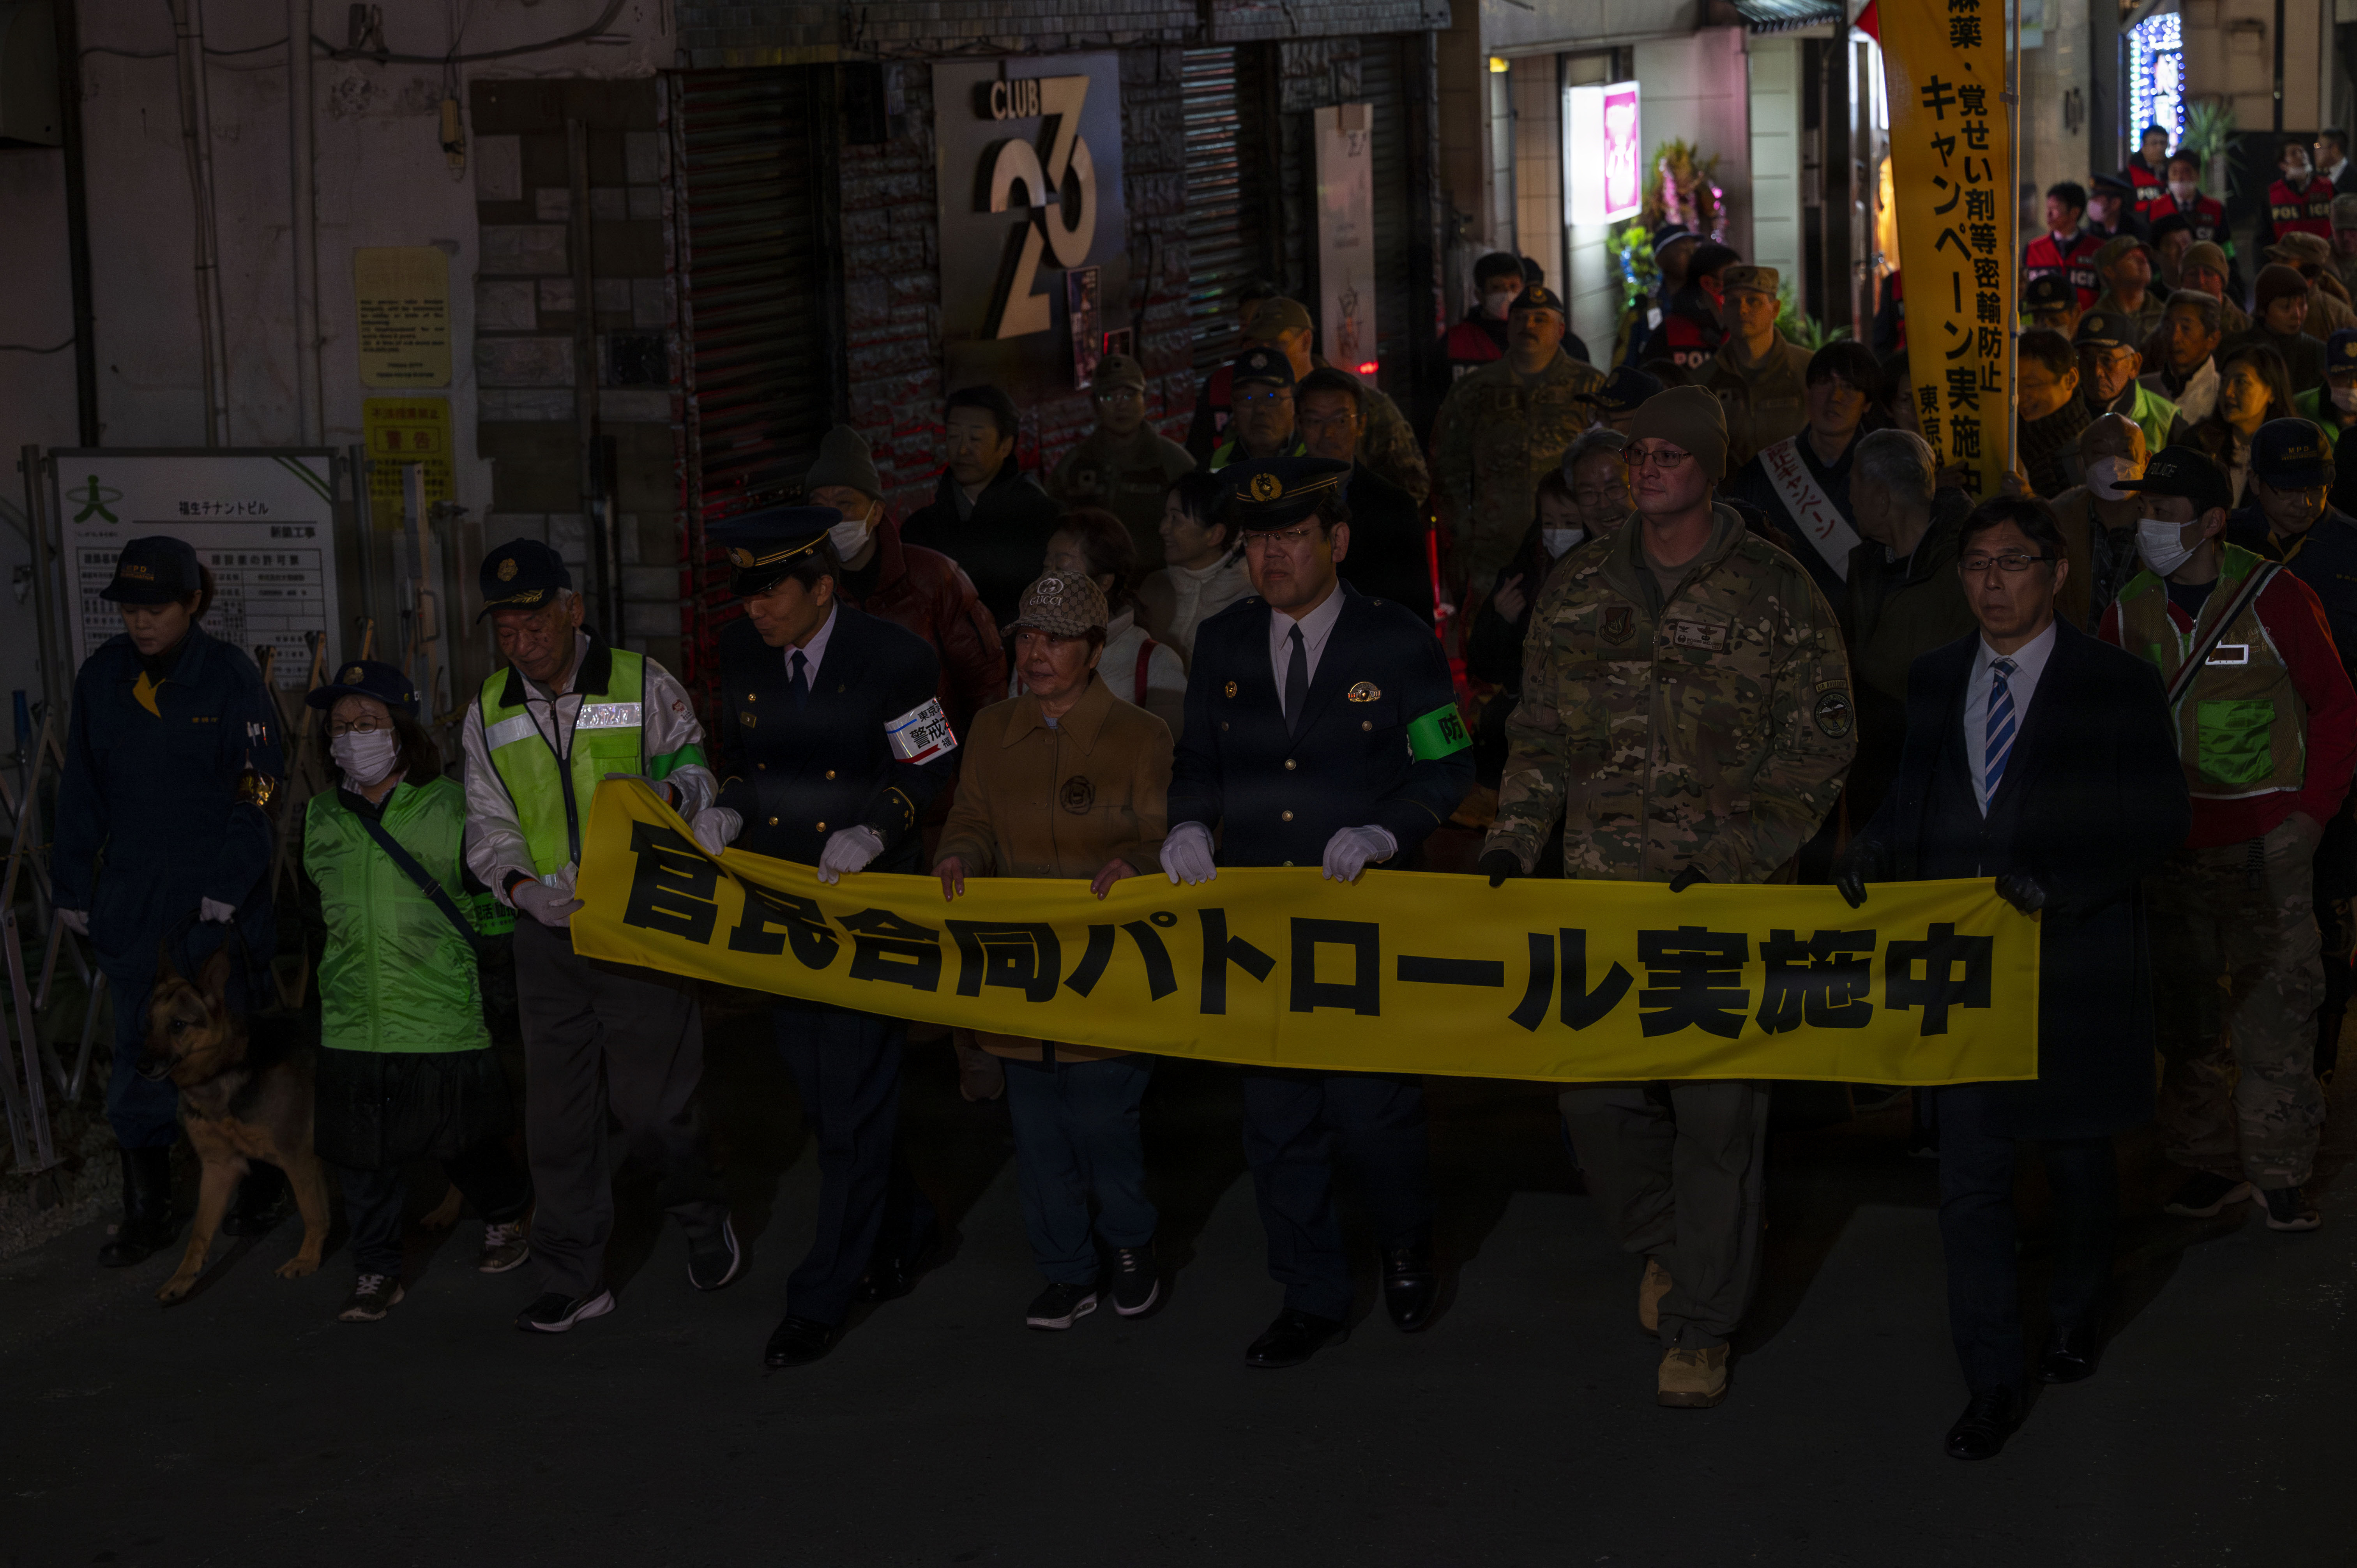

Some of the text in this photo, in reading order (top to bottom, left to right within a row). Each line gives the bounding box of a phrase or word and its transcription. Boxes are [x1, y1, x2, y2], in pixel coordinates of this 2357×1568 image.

[990, 79, 1039, 120] CLUB
[2272, 205, 2299, 221] POL
[178, 500, 269, 516] 福生テナントビル
[1030, 595, 1063, 606] GUCCI
[1438, 713, 1463, 745] 防
[942, 736, 952, 748] 福
[623, 819, 1993, 1039] 官民合同パトロール実施中
